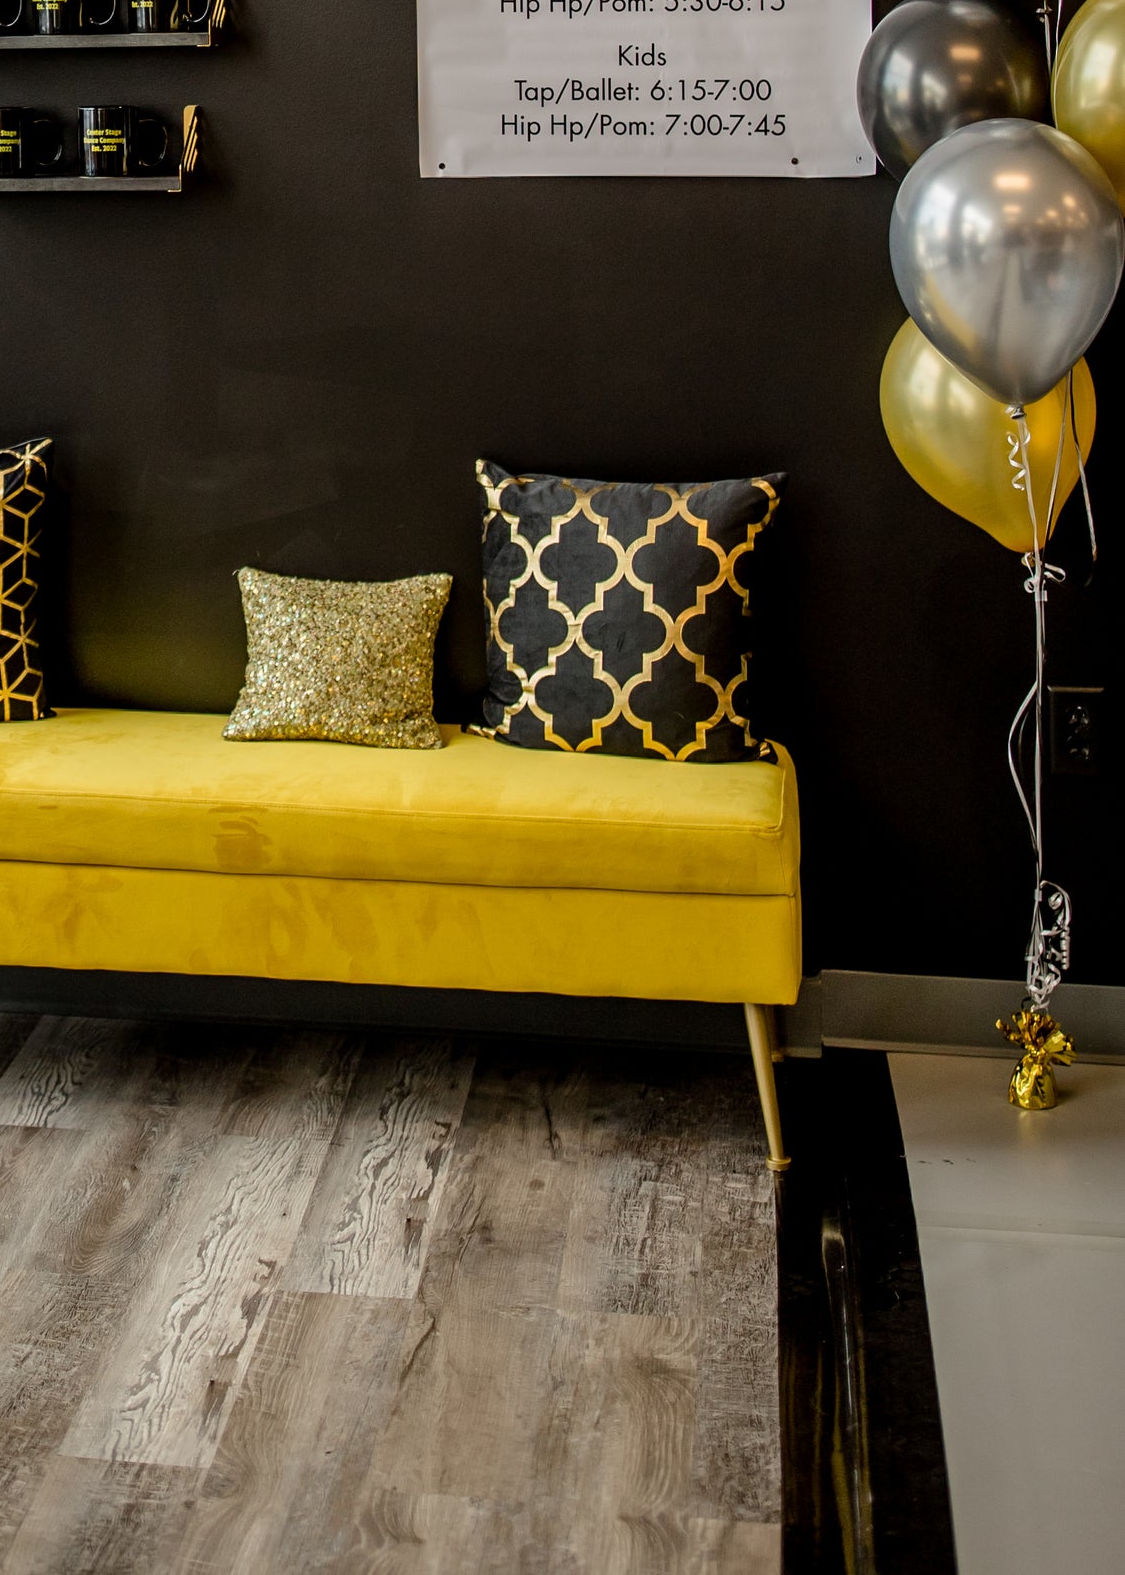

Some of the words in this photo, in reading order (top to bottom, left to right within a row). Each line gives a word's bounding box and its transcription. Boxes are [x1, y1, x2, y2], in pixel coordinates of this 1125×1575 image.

[619, 43, 666, 66] Kids
[514, 78, 639, 107] Tap/Ballet:
[651, 79, 771, 101] 6:15-7:00
[502, 114, 540, 142] Hip
[551, 113, 654, 142] Hp/Pom:
[666, 114, 785, 136] 7:00-7:45
